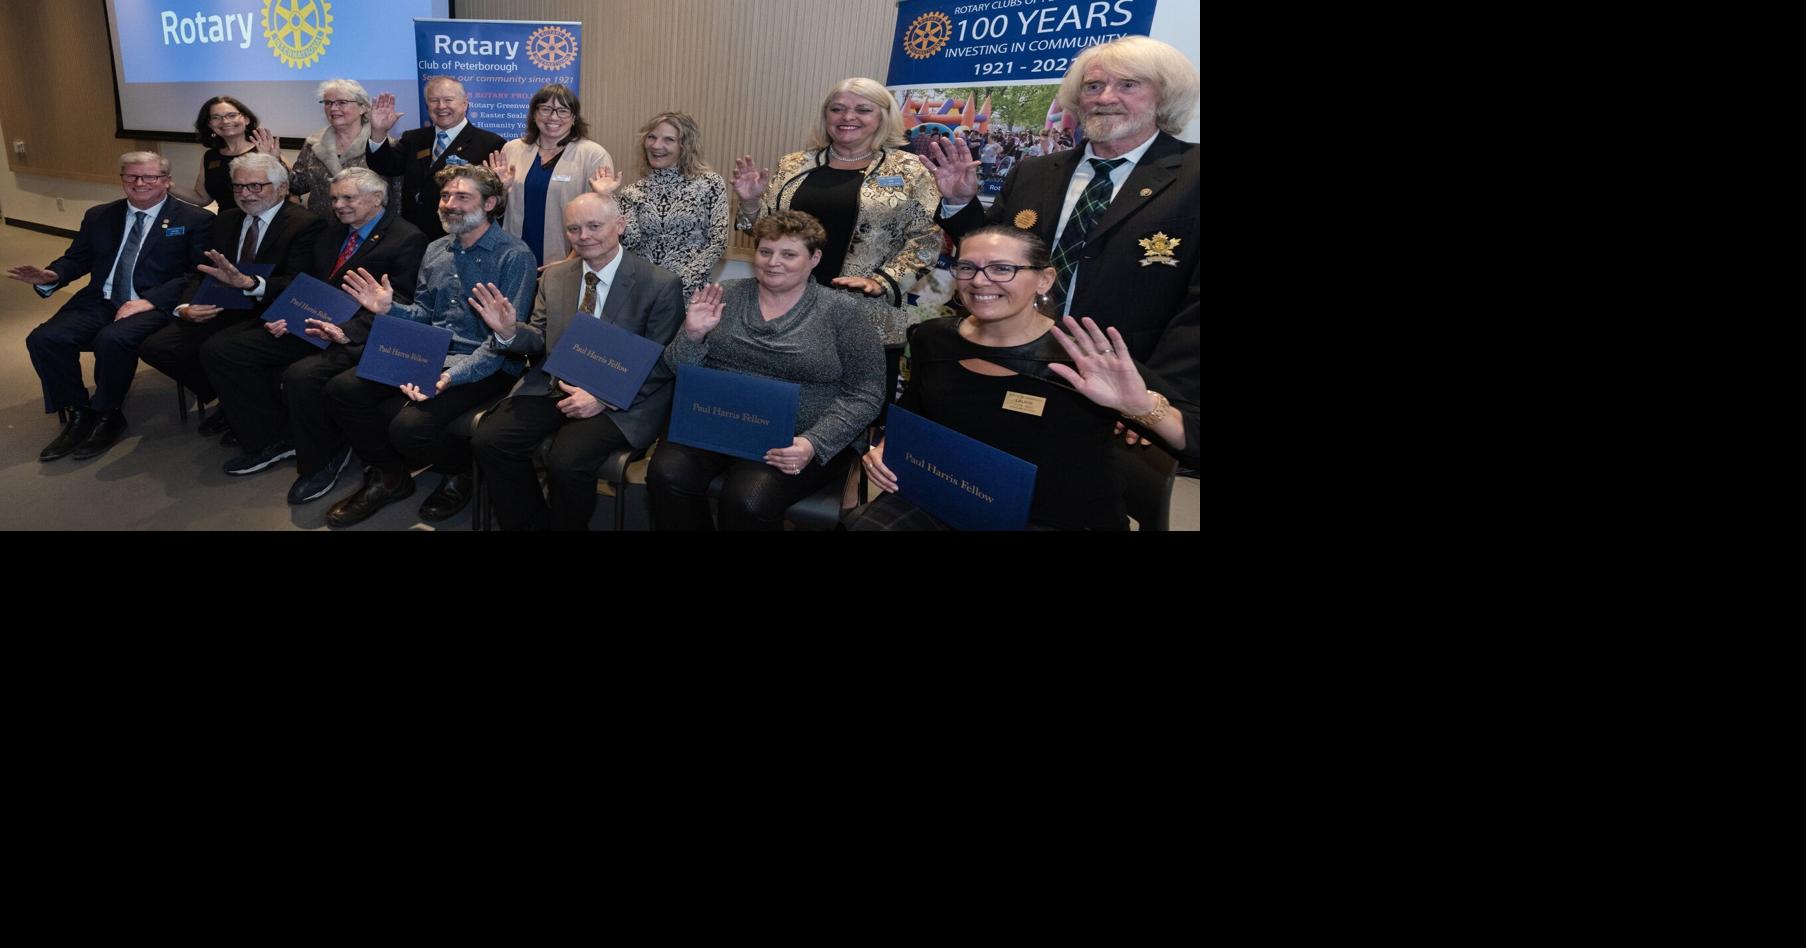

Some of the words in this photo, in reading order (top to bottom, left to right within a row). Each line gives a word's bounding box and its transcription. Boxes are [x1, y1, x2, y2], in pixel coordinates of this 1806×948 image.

[954, 3, 990, 15] ROTARY
[991, 0, 1022, 10] CLUBS
[161, 11, 253, 49] Rotary
[957, 14, 1009, 42] 100
[1017, 0, 1134, 36] YEARS
[434, 34, 520, 60] Rotary
[944, 43, 1008, 58] INVESTING
[1011, 42, 1026, 53] IN
[1029, 33, 1128, 51] COMMUNITY
[418, 60, 439, 70] Club
[441, 60, 452, 70] of
[454, 61, 518, 73] Peterborough
[973, 61, 1013, 76] 1921
[475, 75, 526, 84] community
[527, 76, 551, 84] since
[554, 76, 574, 84] 1921
[468, 102, 495, 110] Rotary
[480, 111, 504, 119] Easter
[477, 121, 516, 130] Humanity
[573, 343, 587, 356] Paul
[587, 348, 608, 366] Harris
[607, 358, 630, 374] Fellow
[692, 402, 712, 416] Paul
[712, 405, 740, 421] Harris
[741, 411, 771, 426] Fellow
[905, 452, 925, 468] Paul
[927, 462, 958, 486] Harris
[960, 479, 994, 504] Fellow
